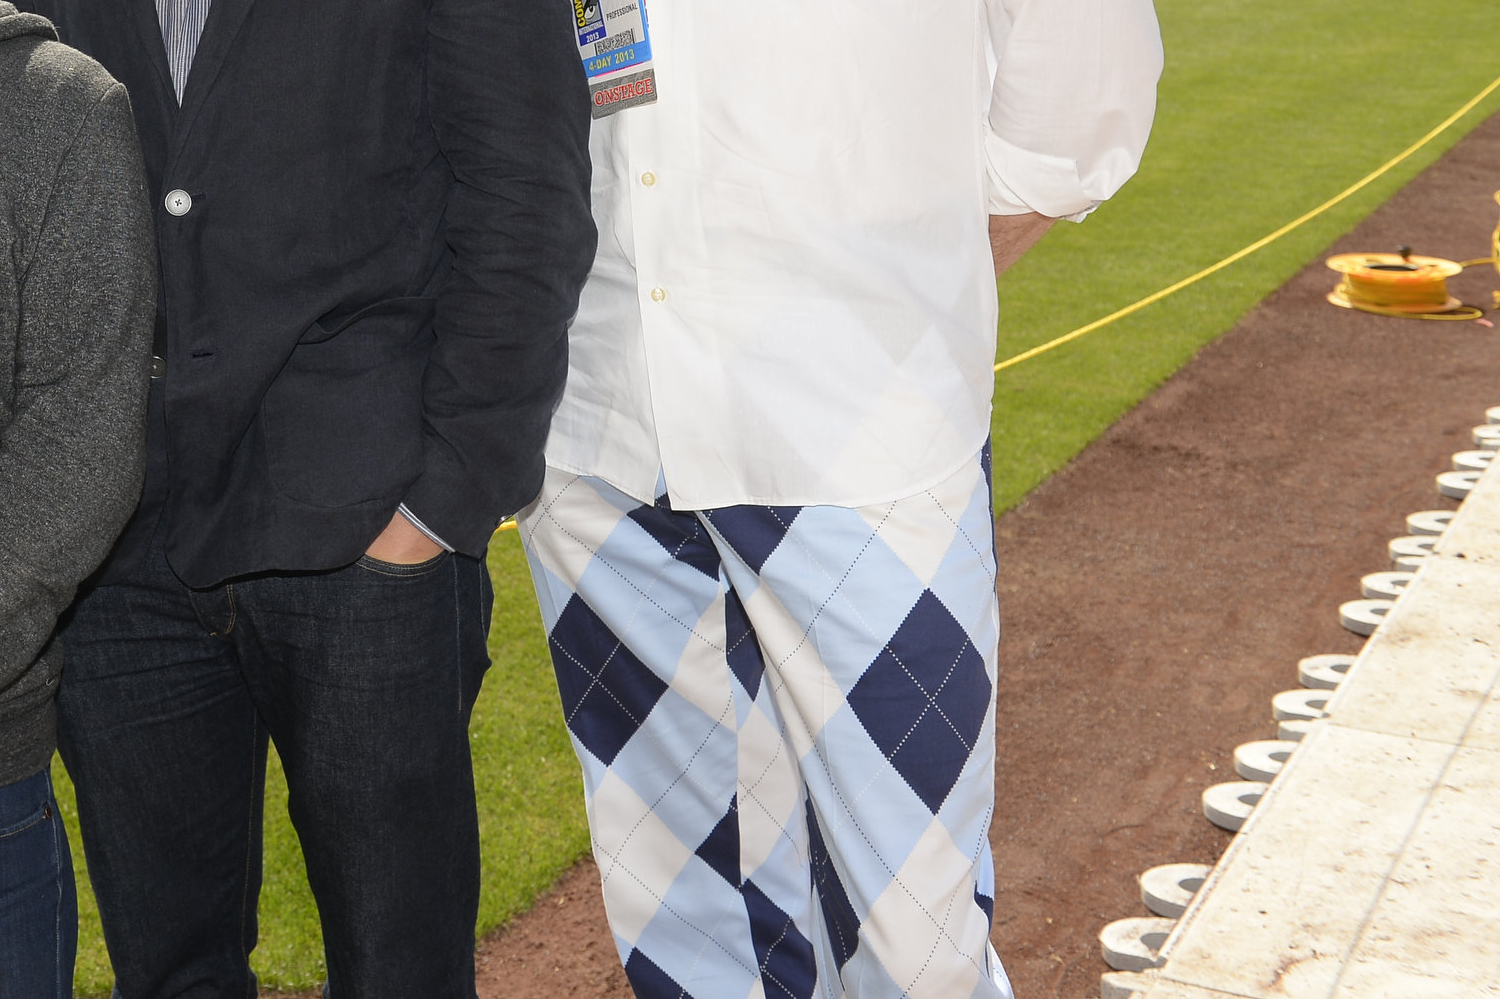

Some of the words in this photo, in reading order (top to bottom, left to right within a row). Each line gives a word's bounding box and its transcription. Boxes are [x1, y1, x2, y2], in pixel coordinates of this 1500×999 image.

[606, 2, 638, 21] PROFESSIONAL
[586, 31, 600, 43] 2013
[588, 56, 612, 72] 4-DAY
[615, 48, 635, 64] 2013
[594, 78, 653, 107] ONSTAGE
